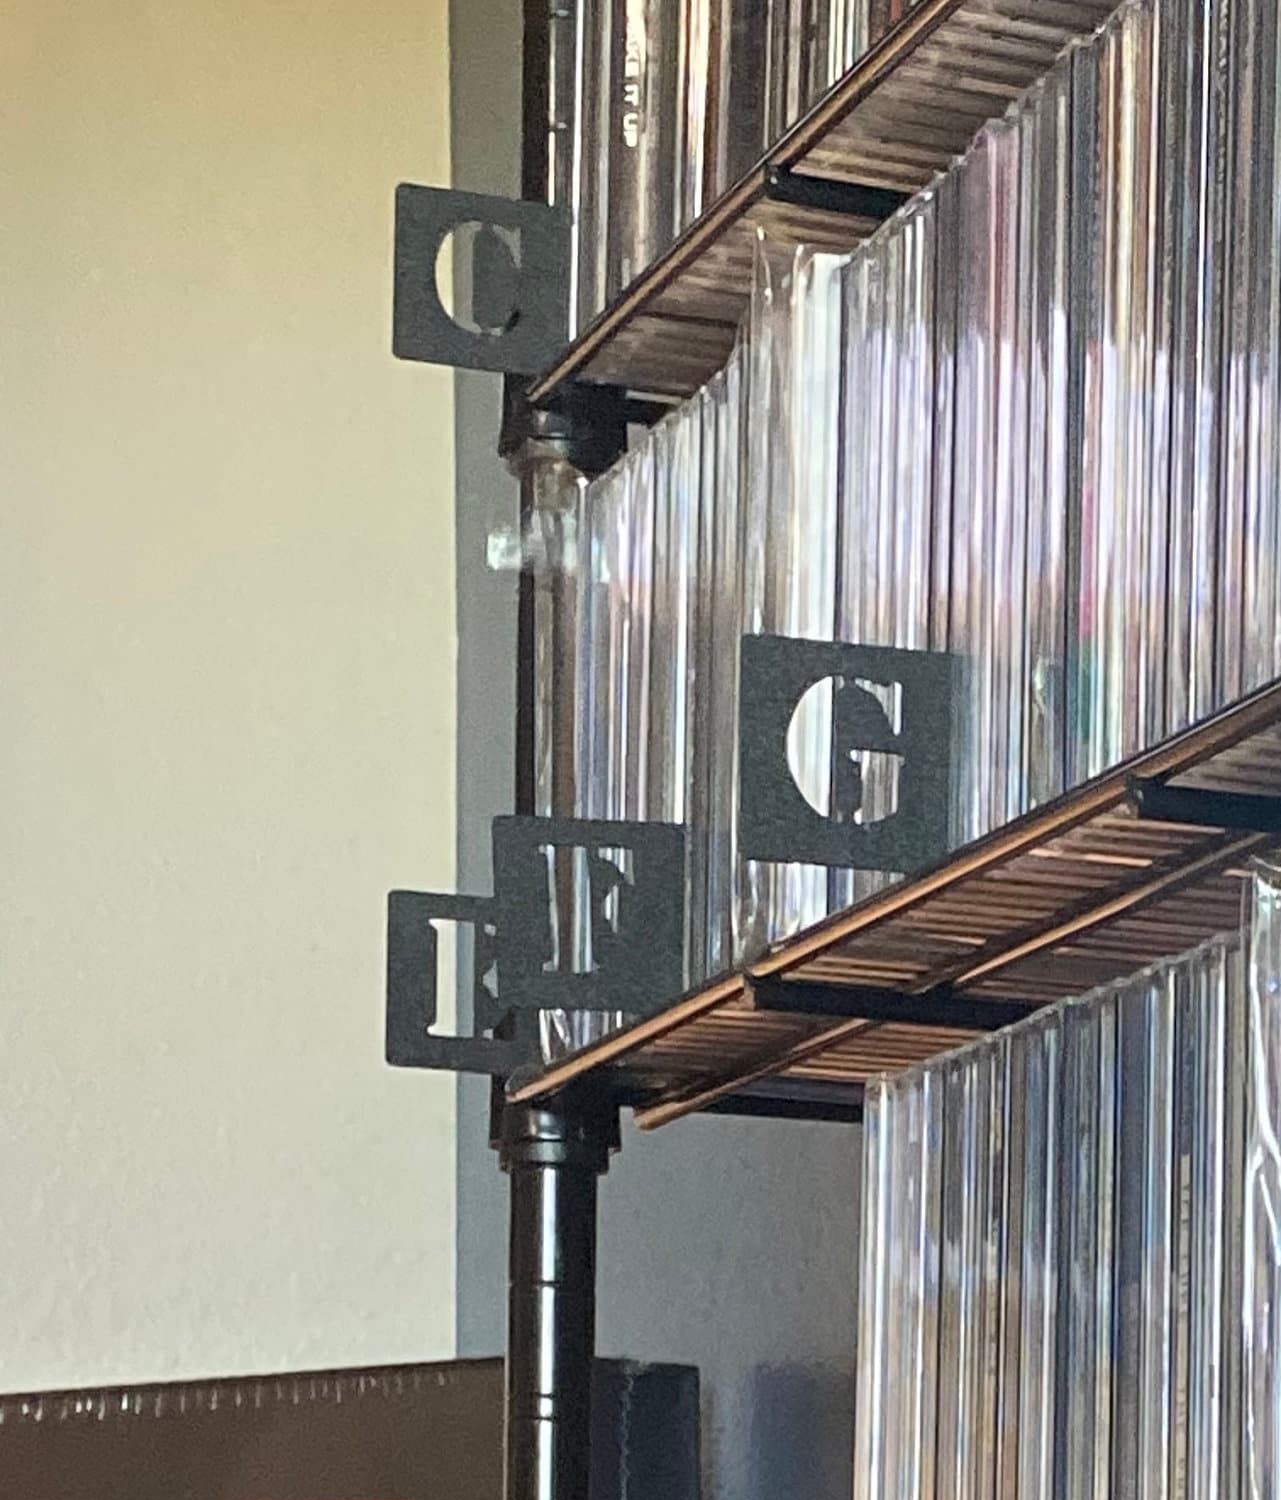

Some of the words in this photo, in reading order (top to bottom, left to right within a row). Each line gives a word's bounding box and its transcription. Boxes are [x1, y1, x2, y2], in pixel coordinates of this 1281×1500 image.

[434, 219, 522, 338] C
[786, 675, 906, 829] G
[537, 843, 635, 974] F
